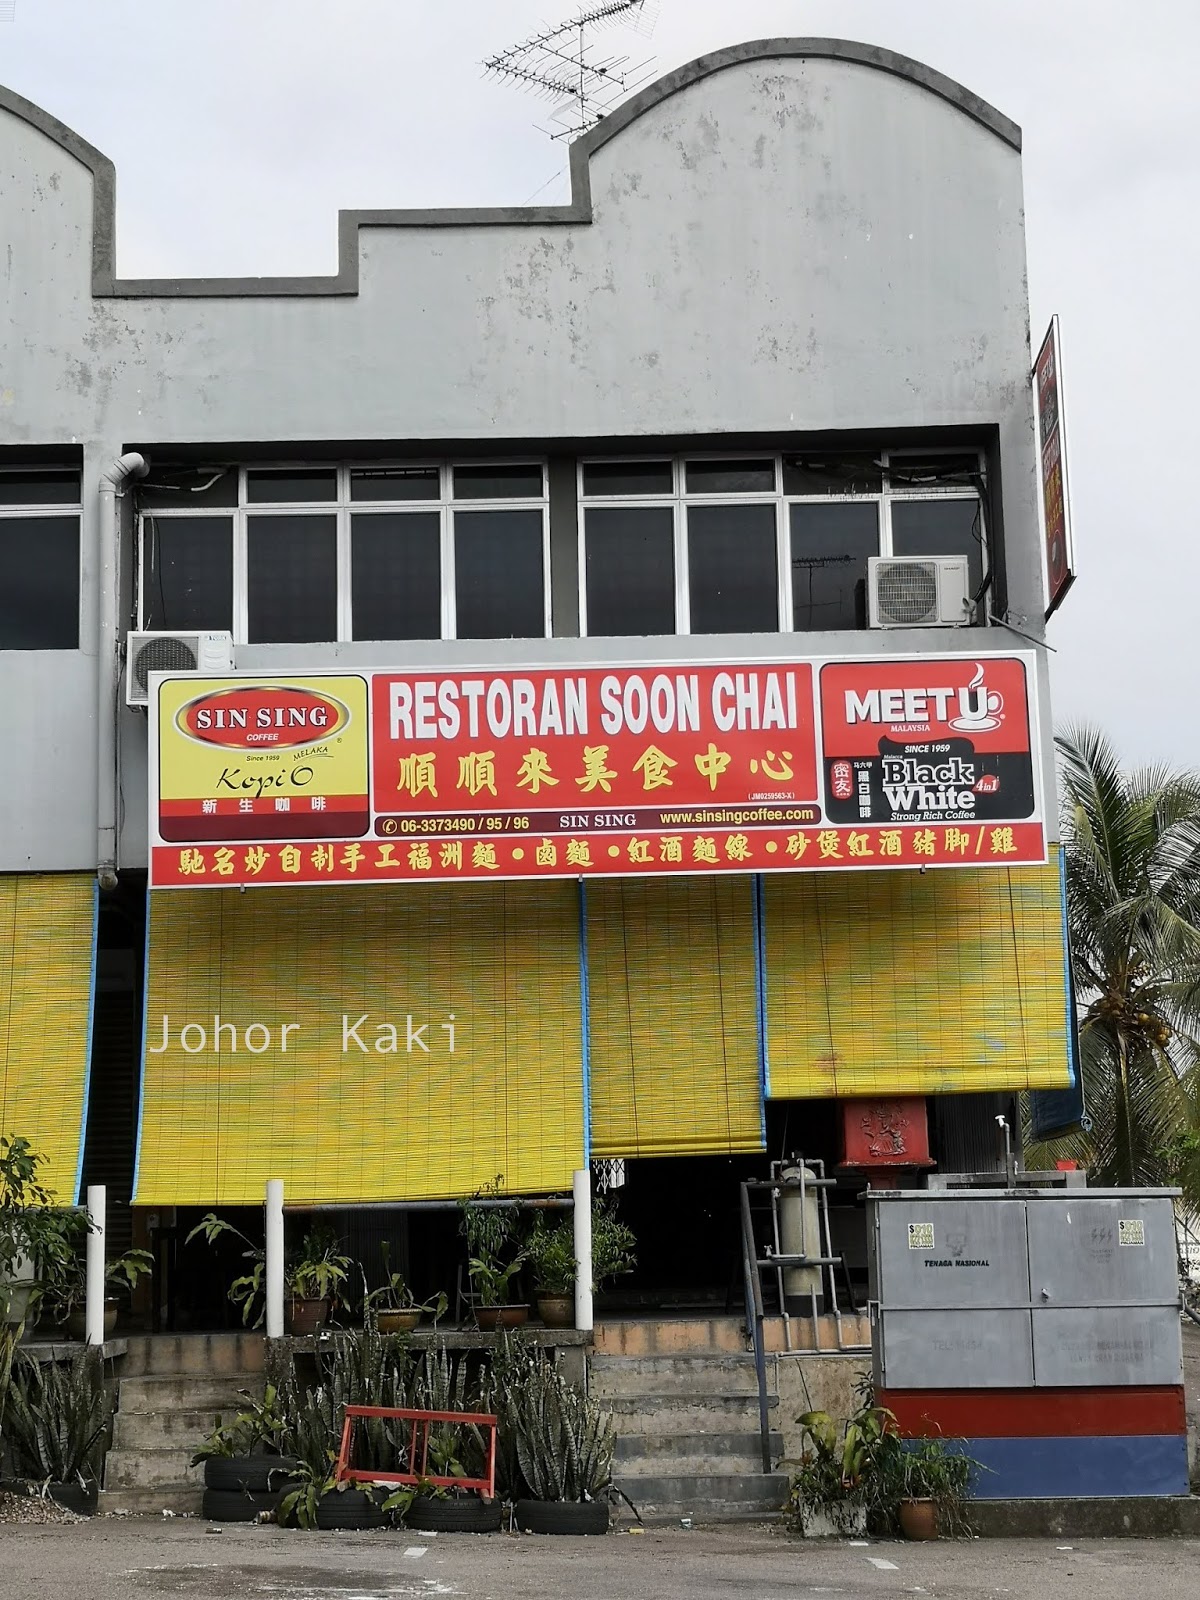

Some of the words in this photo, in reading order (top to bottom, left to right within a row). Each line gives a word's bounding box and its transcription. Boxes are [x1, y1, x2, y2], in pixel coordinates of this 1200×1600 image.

[389, 677, 589, 740] RESTORAN
[600, 673, 701, 735] SOON
[711, 671, 798, 732] CHAI
[196, 708, 248, 729] SIN
[256, 706, 328, 728] SING
[890, 724, 931, 733] MALAYSIA
[246, 733, 279, 742] COFFEE
[293, 746, 329, 762] MELAKA
[904, 745, 929, 754] SINCE
[931, 744, 951, 753] 1959
[397, 742, 794, 797] 順順來美食中心
[834, 763, 851, 793] 密友
[882, 757, 975, 787] Black
[976, 778, 998, 792] 4in1
[202, 796, 327, 813] 新生咖啡
[882, 785, 976, 811] White
[400, 817, 475, 833] 06-3373490
[486, 817, 502, 829] 95
[513, 816, 530, 829] 96
[559, 815, 589, 828] SIN
[594, 814, 637, 827] SING
[660, 808, 814, 825] www.sinsingcoffee.com
[890, 811, 922, 822] Strong
[923, 811, 943, 820] Rich
[945, 810, 976, 819] Coffee
